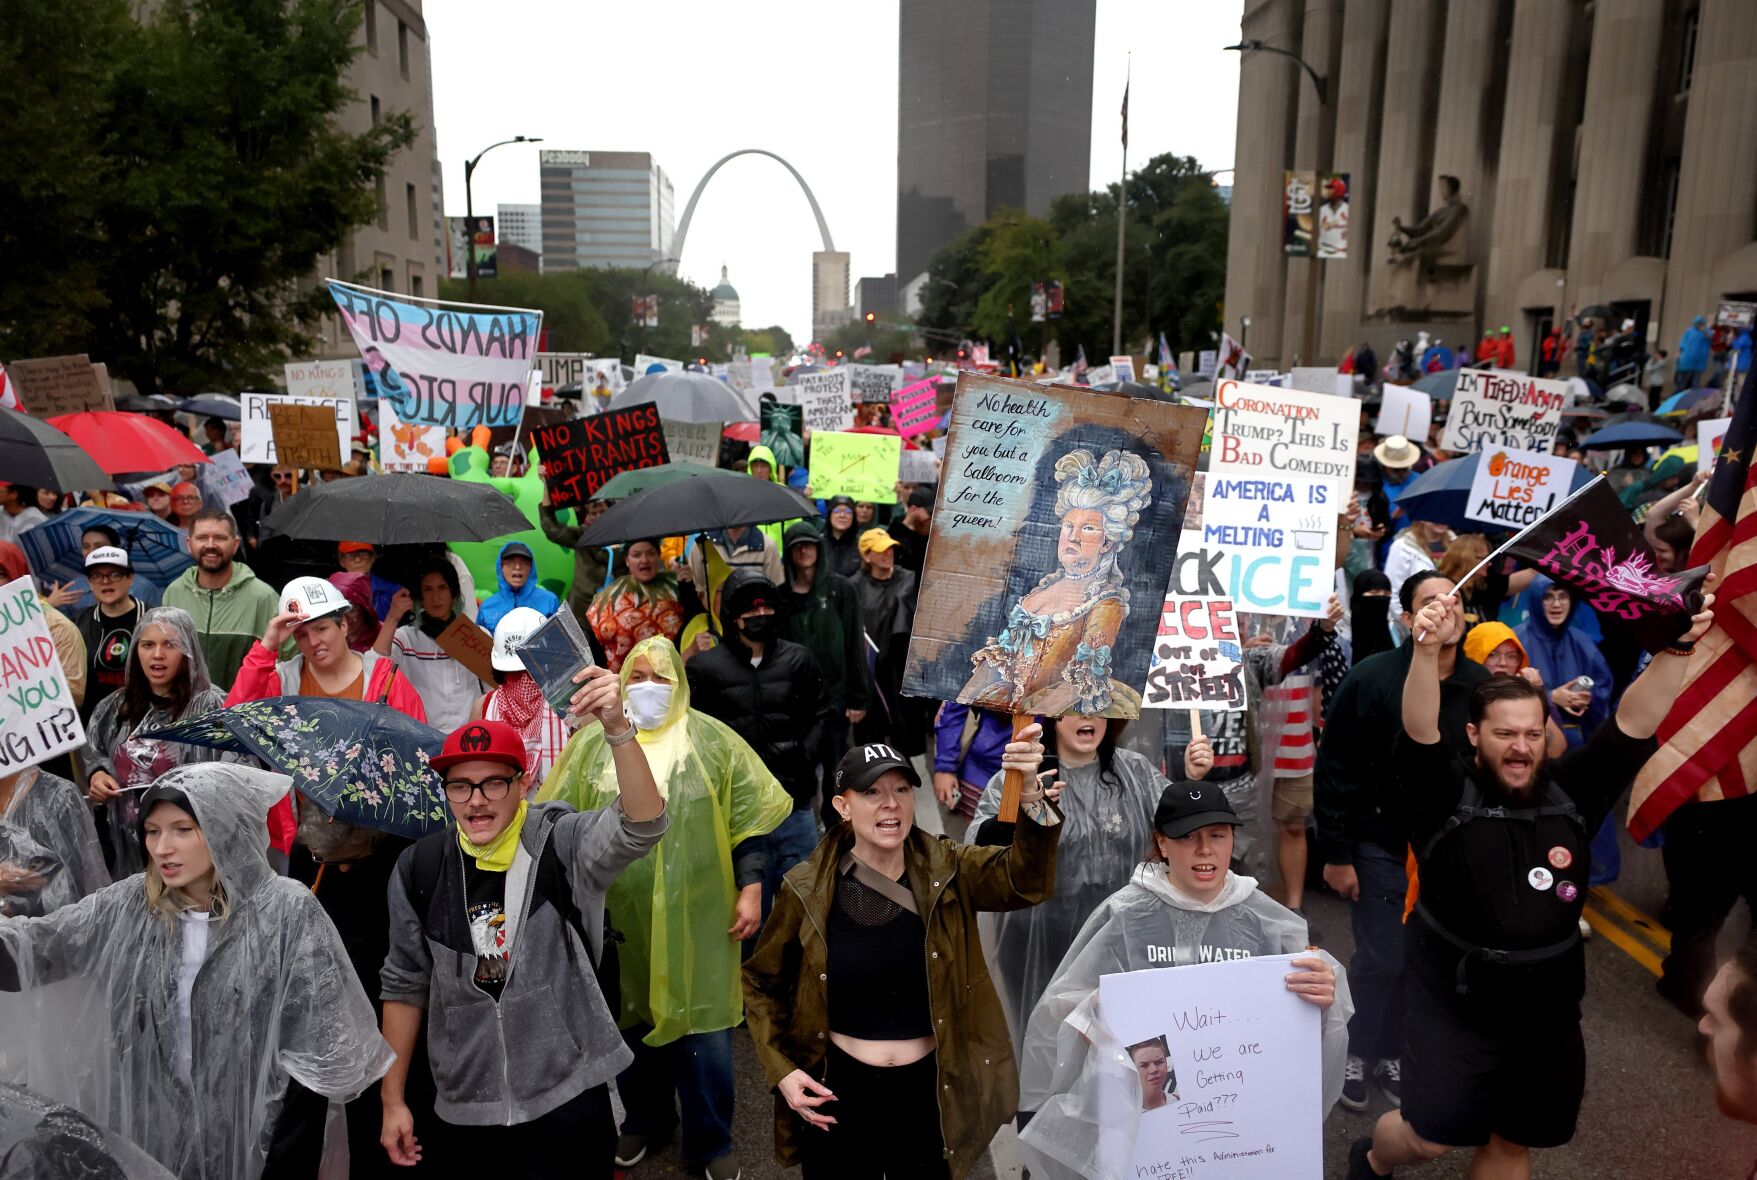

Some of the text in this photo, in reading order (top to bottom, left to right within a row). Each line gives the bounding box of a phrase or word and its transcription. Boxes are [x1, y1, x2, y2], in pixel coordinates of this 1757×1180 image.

[541, 150, 589, 167] Peabody
[309, 367, 345, 380] KINGS
[533, 358, 583, 385] UMP
[977, 393, 1050, 417] No health
[541, 426, 570, 450] NO
[584, 407, 657, 442] KINGS
[972, 419, 1025, 439] care for
[962, 443, 1028, 462] you but a
[963, 462, 1027, 485] ballroom
[1488, 452, 1550, 486] Orange
[947, 486, 1005, 506] for the
[1212, 480, 1328, 504] AMERICA IS
[1492, 480, 1534, 503] Lies
[952, 513, 1002, 529] queen!
[1257, 504, 1270, 522] A
[1204, 524, 1284, 548] MELTING
[1167, 548, 1322, 612] CK ICE
[1157, 600, 1237, 641] ICE
[0, 636, 54, 688] AND
[1200, 647, 1219, 661] OF
[8, 676, 60, 715] YOU
[36, 707, 76, 751] IT?
[864, 743, 902, 763] ATL
[1147, 944, 1190, 962] DRI
[1238, 1041, 1263, 1055] are
[1196, 1070, 1245, 1089] Getting
[1177, 1093, 1238, 1118] Paid???
[1136, 1161, 1172, 1178] hate
[1180, 1155, 1206, 1167] this
